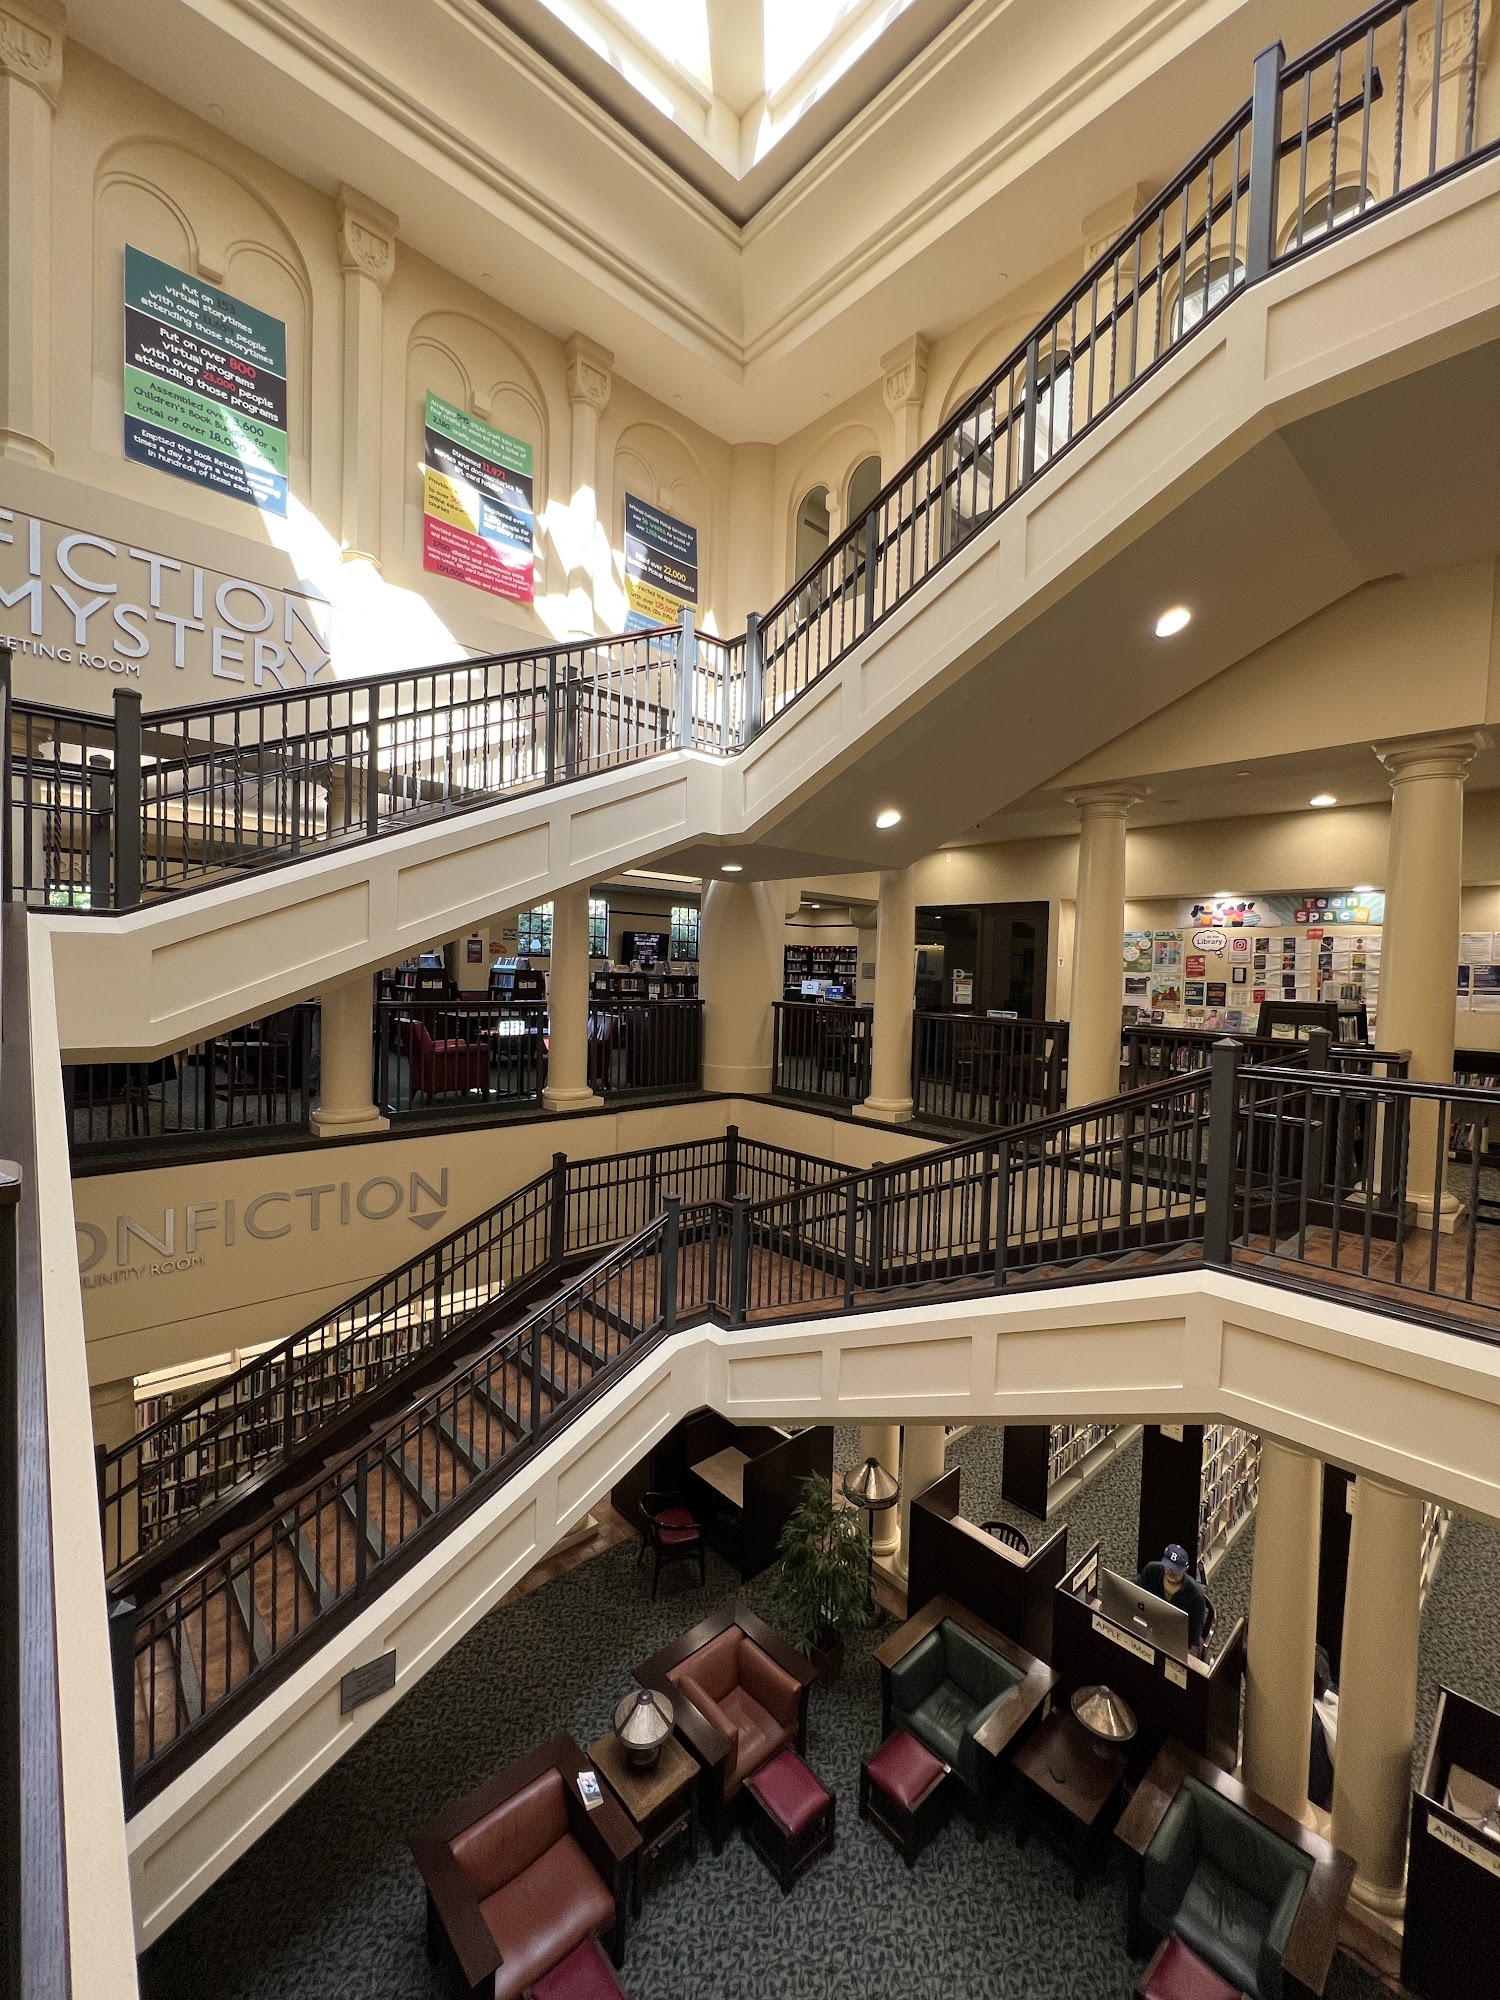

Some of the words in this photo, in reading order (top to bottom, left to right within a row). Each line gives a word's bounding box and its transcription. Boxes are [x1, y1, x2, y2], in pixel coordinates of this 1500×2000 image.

[165, 285, 200, 308] virtual
[203, 304, 252, 334] storytimes
[182, 283, 198, 297] Put
[201, 295, 213, 304] on
[218, 298, 236, 315] 153
[141, 298, 192, 328] attending
[194, 322, 222, 340] those
[225, 337, 274, 365] storytimes
[149, 290, 174, 307] with
[176, 304, 200, 319] over
[236, 334, 266, 352] people
[160, 328, 180, 343] Put
[183, 340, 198, 352] on
[200, 348, 226, 364] over
[230, 357, 256, 378] 800
[162, 341, 202, 366] virtual
[206, 362, 255, 389] programs
[135, 354, 193, 386] attending
[197, 379, 228, 399] those
[231, 396, 278, 422] programs
[140, 343, 170, 362] with
[172, 359, 200, 375] over
[239, 388, 274, 408] people
[134, 387, 185, 414] Children's
[189, 409, 212, 425] Book
[255, 438, 268, 448] for
[150, 382, 203, 410] Assembled
[207, 408, 228, 422] over
[234, 417, 264, 436] 3,600
[137, 402, 164, 418] total
[168, 416, 179, 424] of
[182, 422, 206, 436] over
[210, 430, 246, 452] 18,000
[430, 406, 442, 416] four
[444, 414, 460, 426] crafts
[468, 428, 482, 439] each
[506, 446, 519, 456] total
[431, 400, 456, 417] Arranged
[513, 444, 526, 452] with
[452, 429, 470, 441] crafts
[471, 440, 492, 454] created
[134, 434, 157, 449] times
[194, 460, 213, 471] days
[142, 428, 176, 448] Emptied
[177, 443, 192, 454] the
[194, 450, 212, 462] Book
[214, 458, 244, 474] Returns
[452, 449, 481, 468] Streamed
[148, 449, 156, 458] in
[158, 453, 196, 472] hundreds
[198, 469, 208, 477] of
[210, 473, 232, 486] items
[233, 483, 252, 494] each
[434, 448, 456, 464] movies
[458, 460, 470, 470] and
[470, 466, 514, 491] documentaries
[516, 486, 523, 494] to
[466, 473, 480, 484] card
[429, 486, 436, 494] to
[436, 492, 449, 500] over
[429, 501, 450, 514] courses
[430, 523, 451, 536] Provided
[513, 518, 526, 526] over
[427, 546, 451, 558] borrowed
[428, 552, 441, 560] each
[651, 562, 662, 571] over
[648, 566, 663, 579] Pickup
[664, 575, 694, 593] appointments
[80, 652, 140, 677] ROOM
[1296, 911, 1367, 923] Space
[1304, 898, 1358, 908] Teen
[1197, 938, 1222, 946] Library
[150, 1255, 204, 1276] ROOM
[1170, 1552, 1178, 1562] B
[1096, 1621, 1122, 1641] APPLE
[1130, 1641, 1152, 1660] iMac
[1433, 1826, 1476, 1856] APPLE
